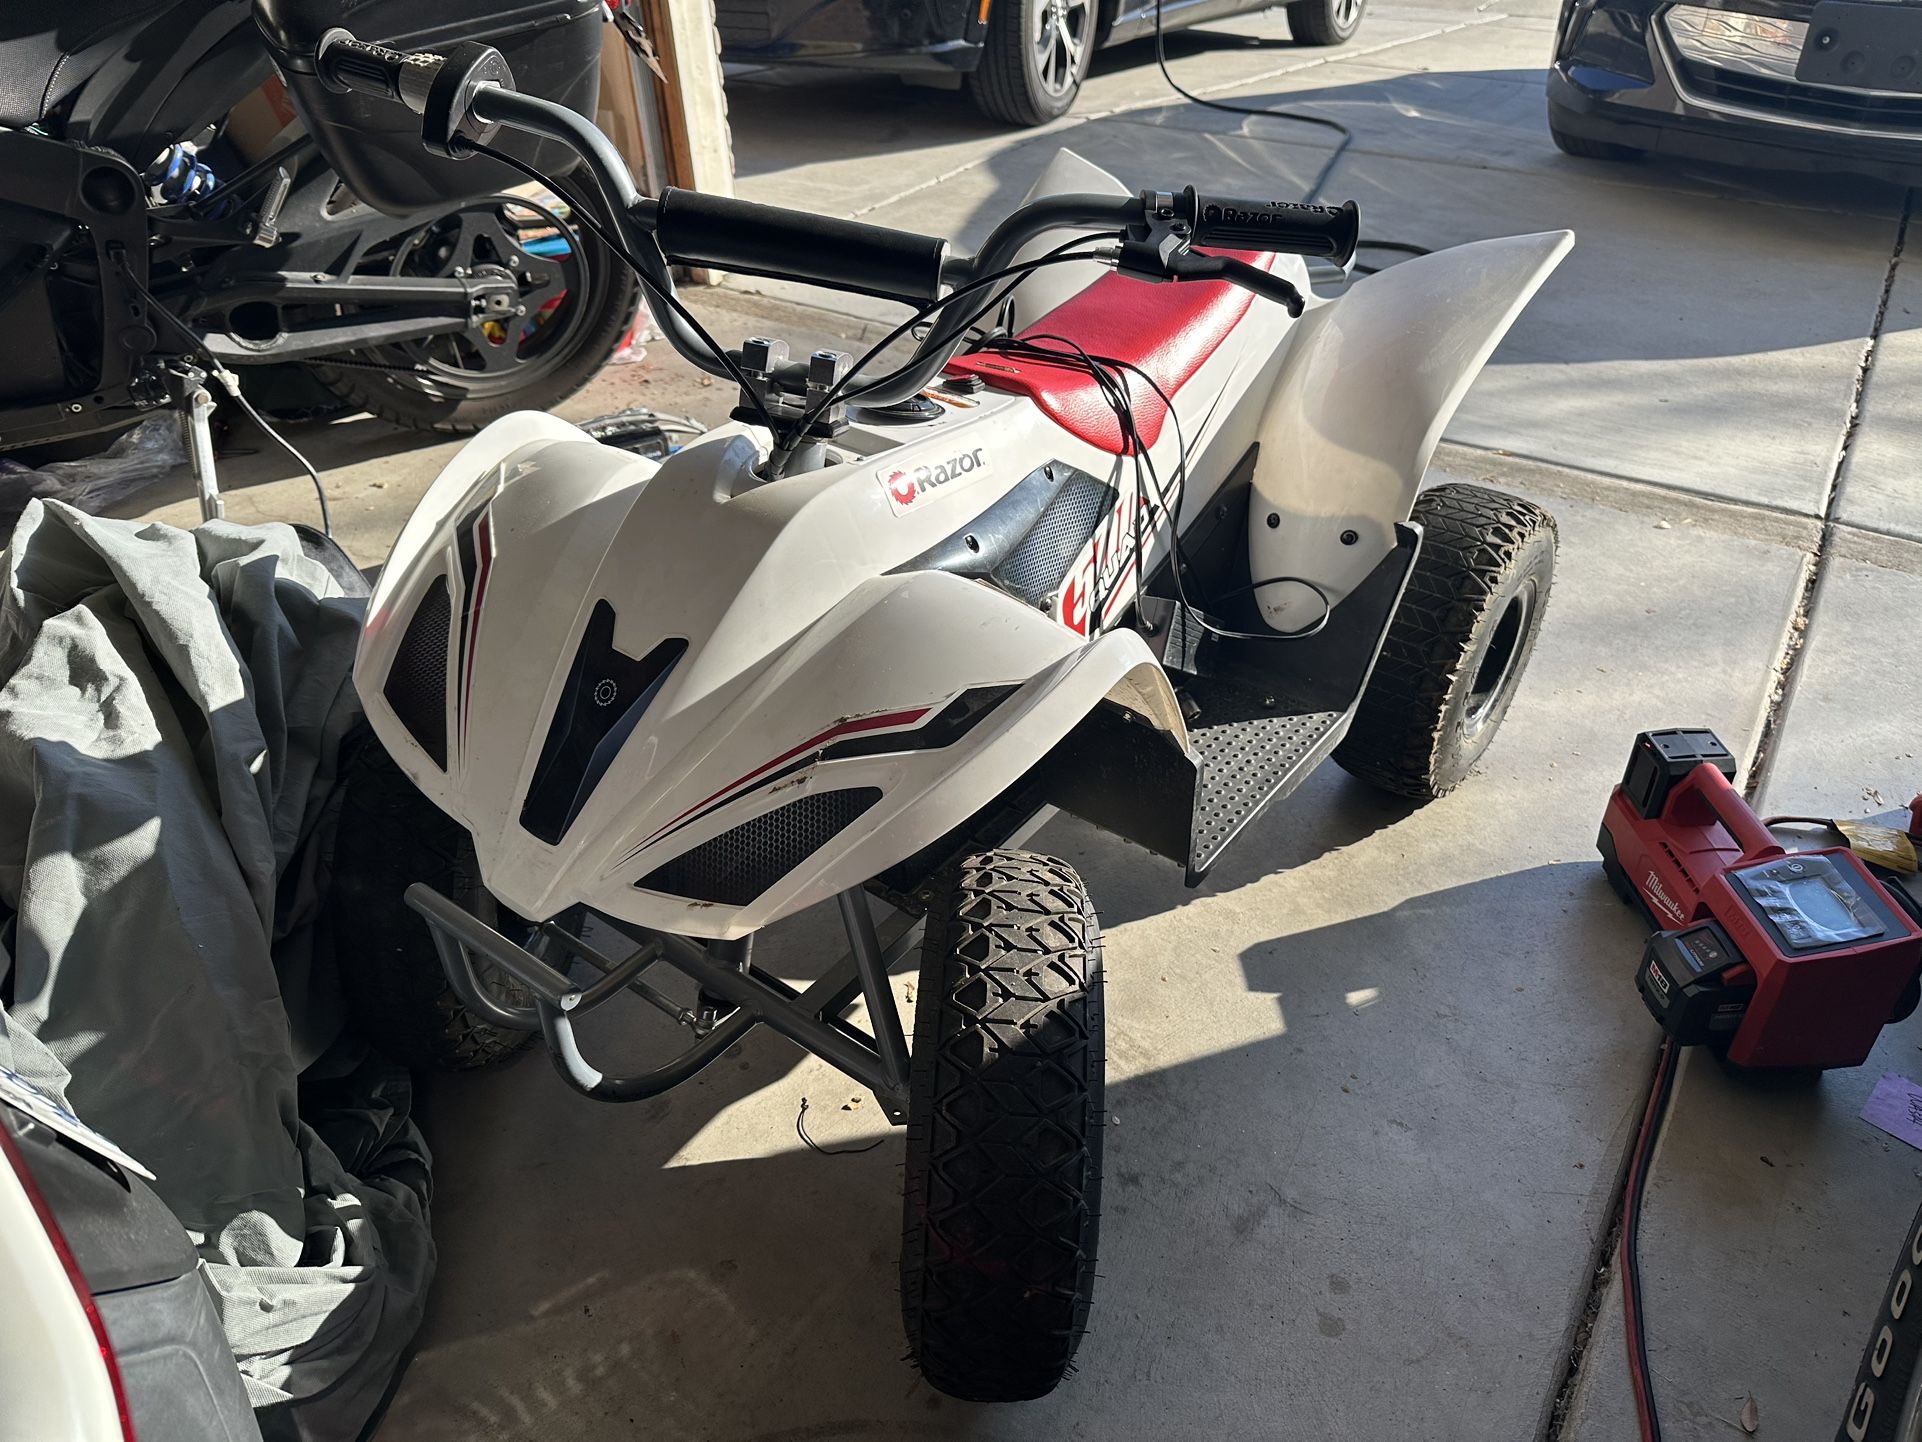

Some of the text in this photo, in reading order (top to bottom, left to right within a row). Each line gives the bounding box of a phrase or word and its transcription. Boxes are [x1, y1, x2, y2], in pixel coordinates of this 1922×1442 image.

[1222, 207, 1283, 225] Razor
[914, 447, 983, 494] Razor
[1646, 870, 1685, 921] Milwaukee
[1650, 963, 1669, 992] M18
